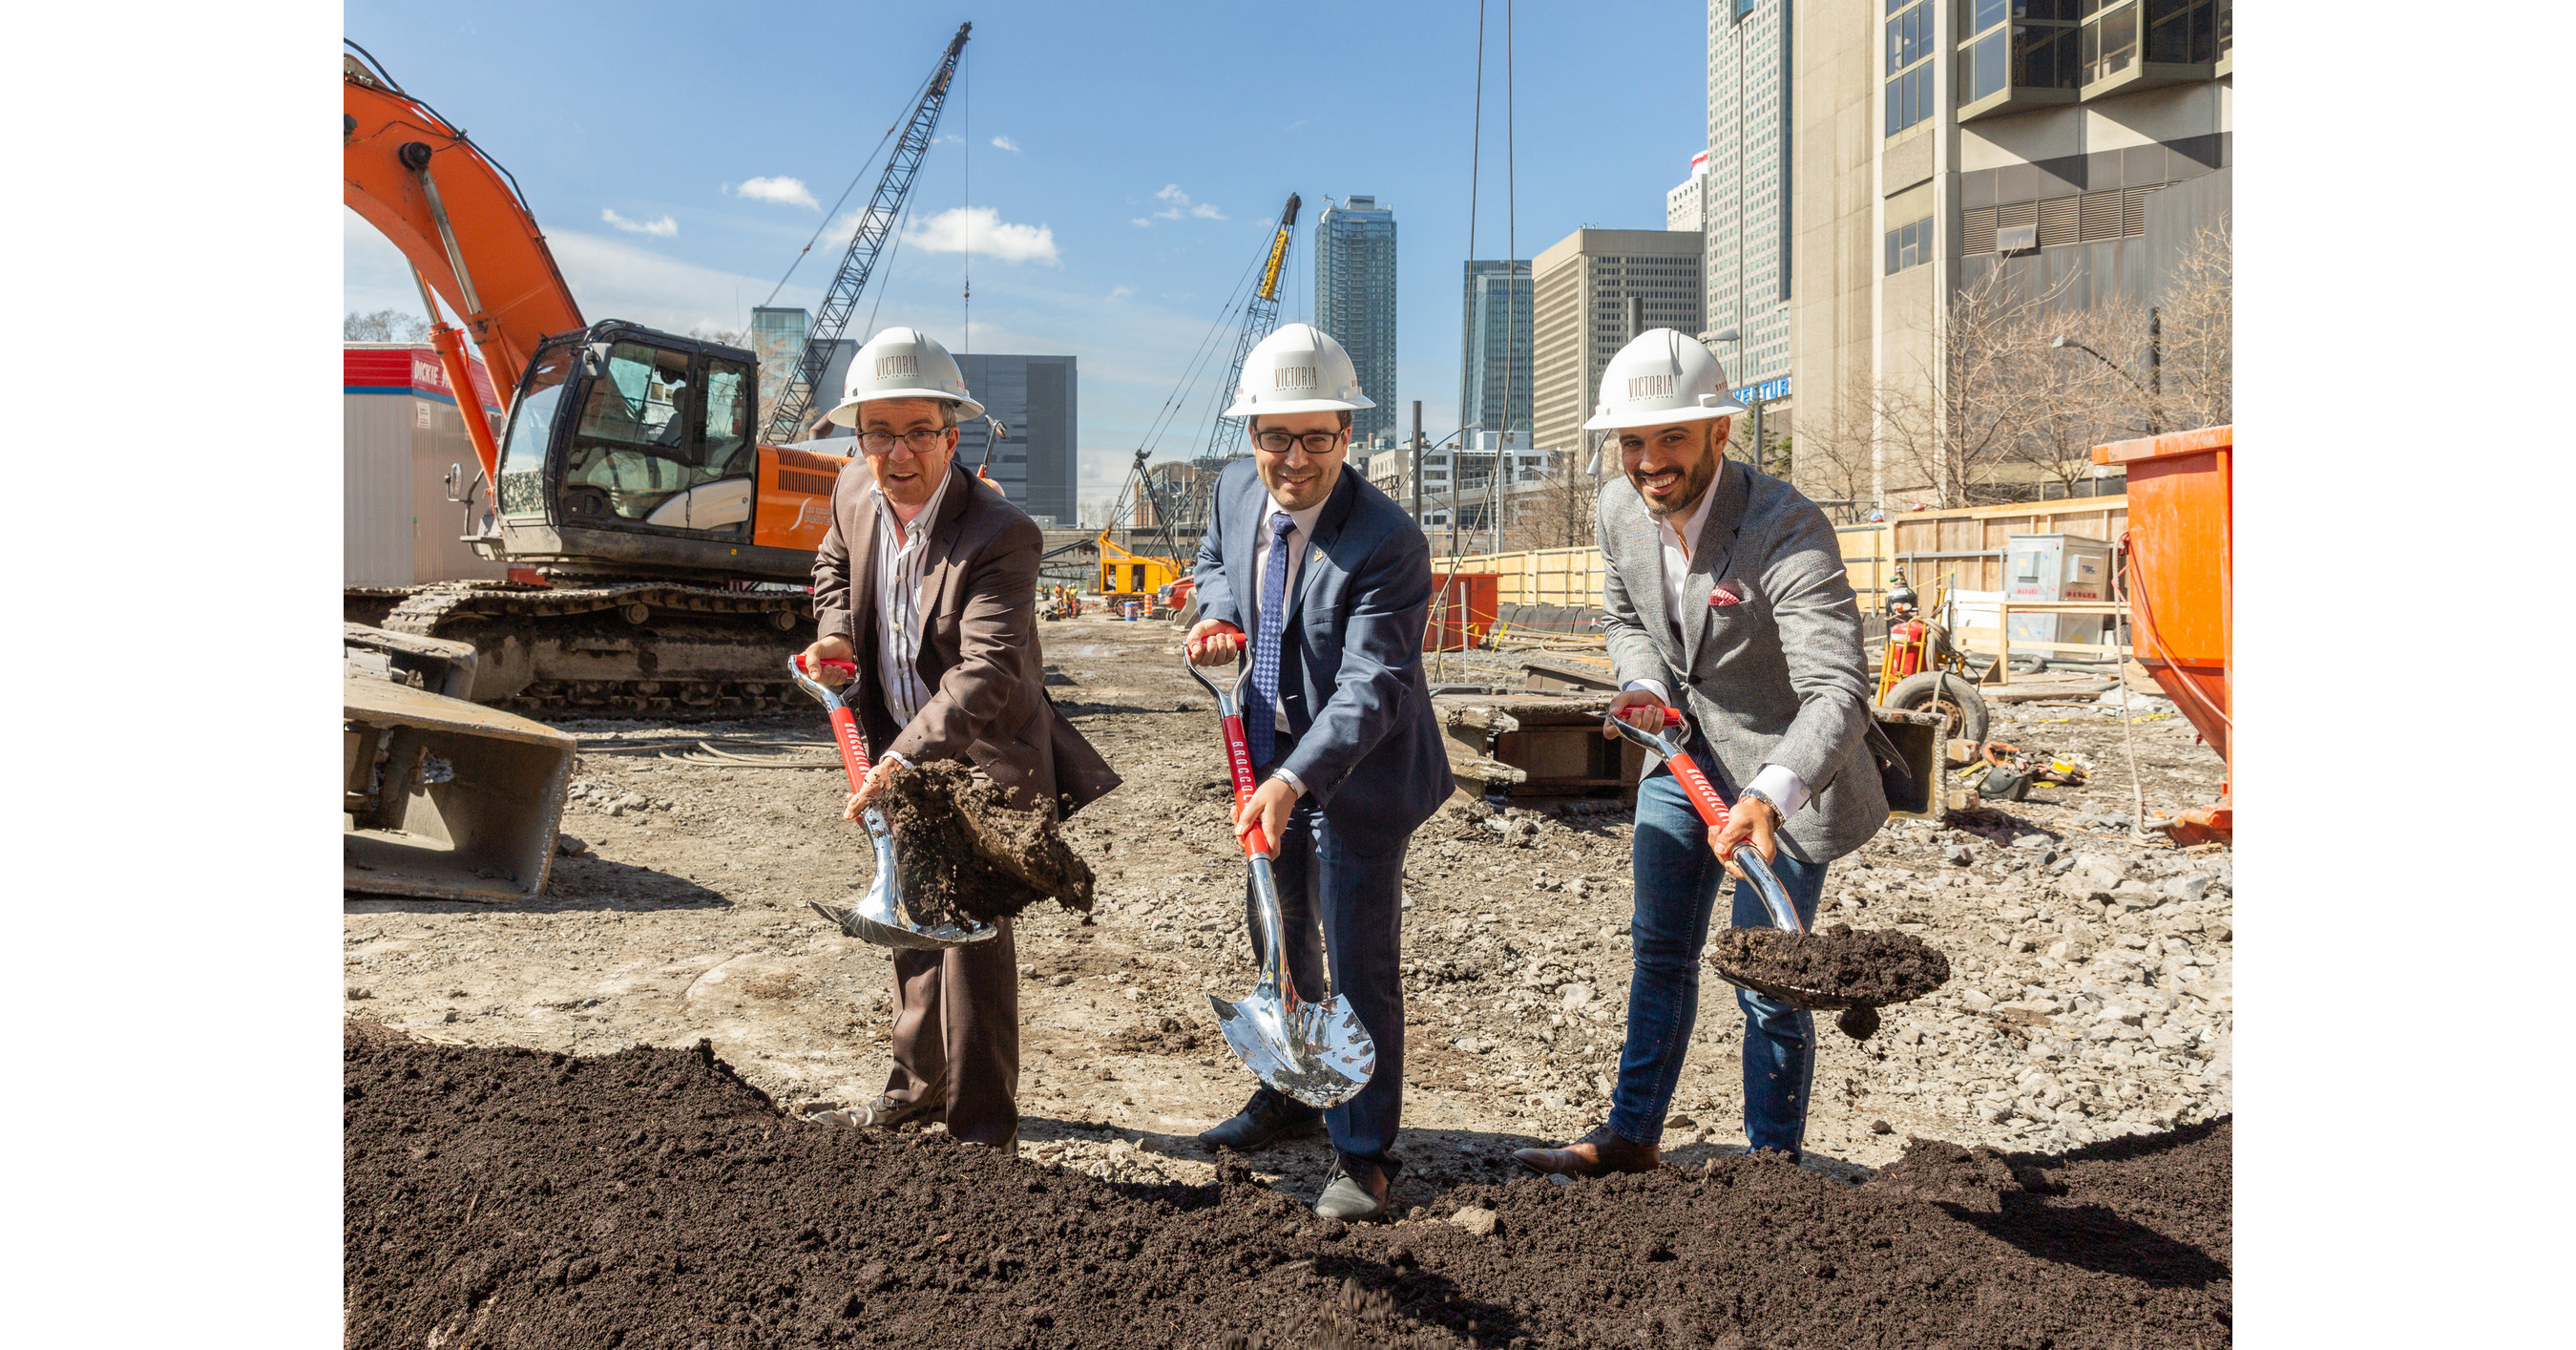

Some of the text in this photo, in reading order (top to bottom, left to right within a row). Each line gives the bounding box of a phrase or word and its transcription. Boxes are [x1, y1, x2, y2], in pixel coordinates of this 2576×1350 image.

[413, 360, 439, 386] DICKIE
[875, 355, 919, 377] VICTORIA
[1275, 367, 1317, 388] VICTORIA
[1628, 374, 1674, 398] VICTORIA
[1733, 377, 1792, 405] VETUR
